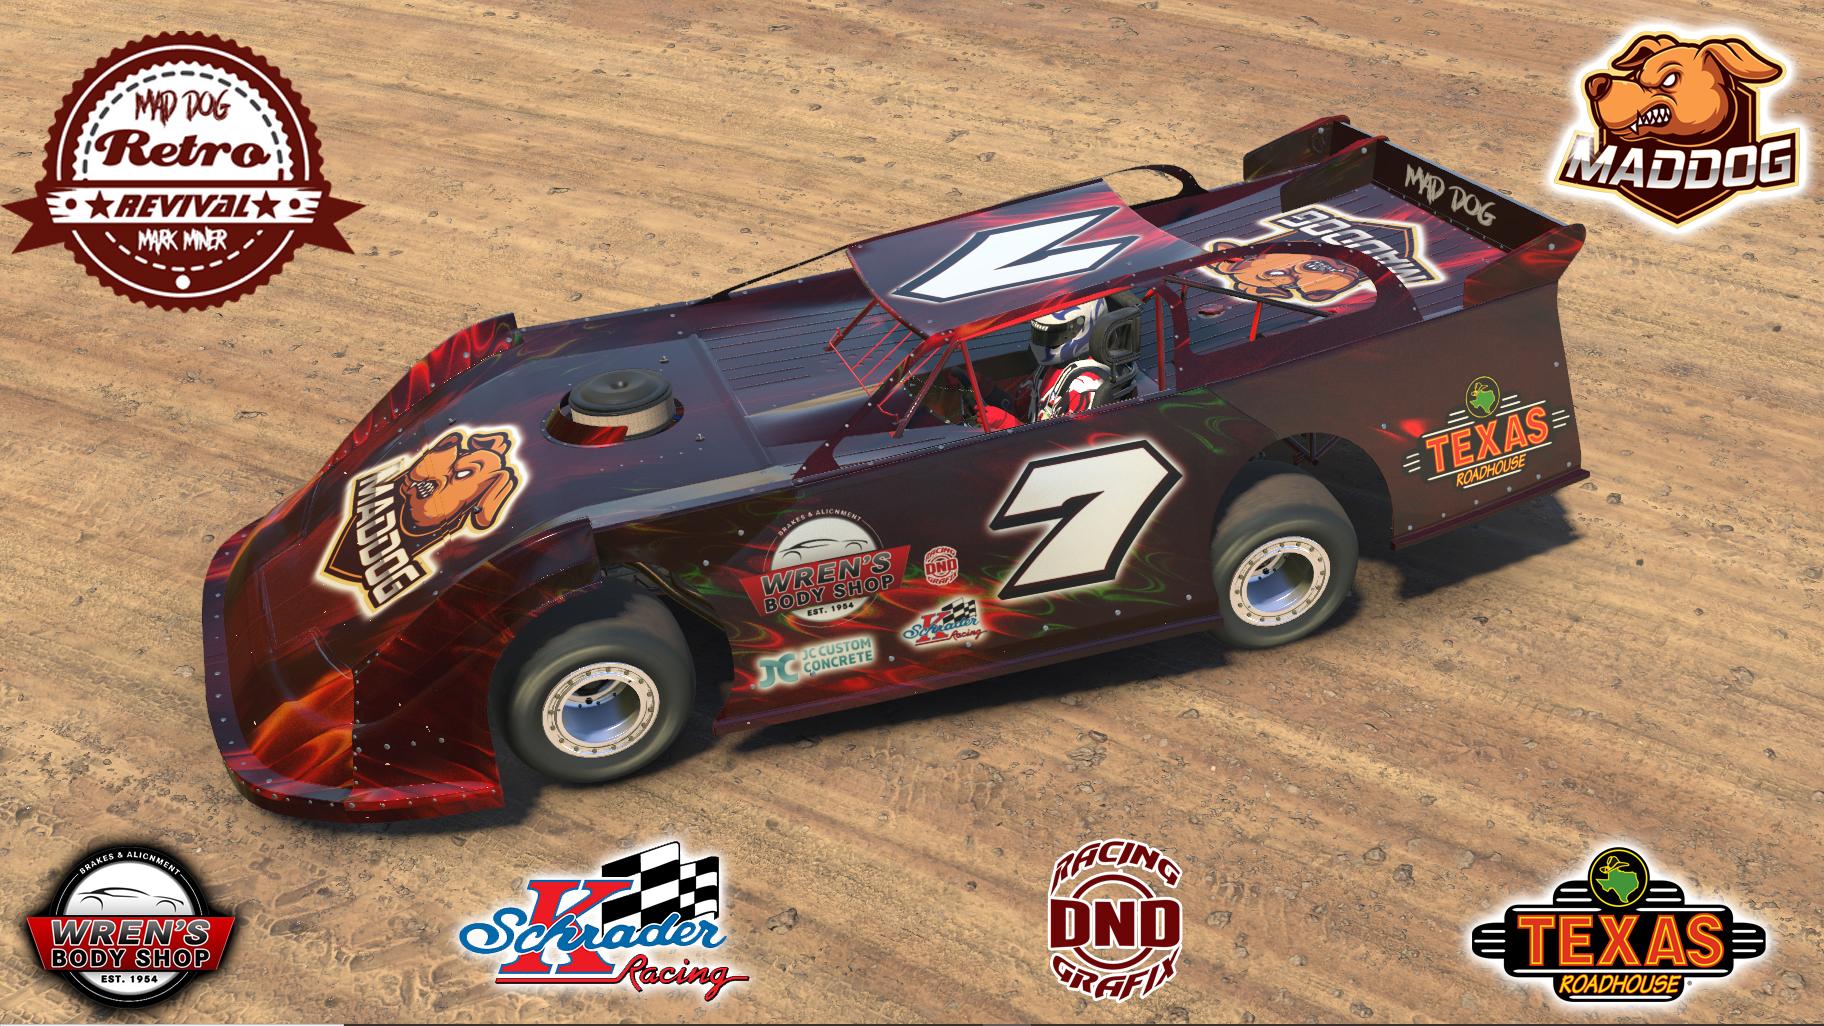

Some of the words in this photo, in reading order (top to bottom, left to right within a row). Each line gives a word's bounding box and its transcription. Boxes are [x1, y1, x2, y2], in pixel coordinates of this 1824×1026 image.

[1405, 164, 1445, 204] MAD
[1449, 185, 1496, 227] DOG
[890, 206, 1141, 303] 7
[1425, 406, 1549, 474] TEXAS
[1456, 454, 1527, 487] ROADHOUSE
[355, 458, 420, 604] MADDOG
[778, 514, 806, 536] BRAKES
[988, 440, 1183, 601] 7
[925, 546, 957, 561] RACING
[925, 559, 957, 575] DND
[760, 551, 892, 597] WREN'S
[764, 587, 824, 614] BODY
[833, 574, 895, 601] SHOP
[807, 608, 828, 617] EST.
[831, 602, 854, 613] 1954
[903, 617, 981, 639] Schrader
[950, 628, 985, 641] Racing
[802, 647, 818, 661] JC
[818, 637, 872, 657] CUSTOM
[803, 650, 873, 673] CONCRETE
